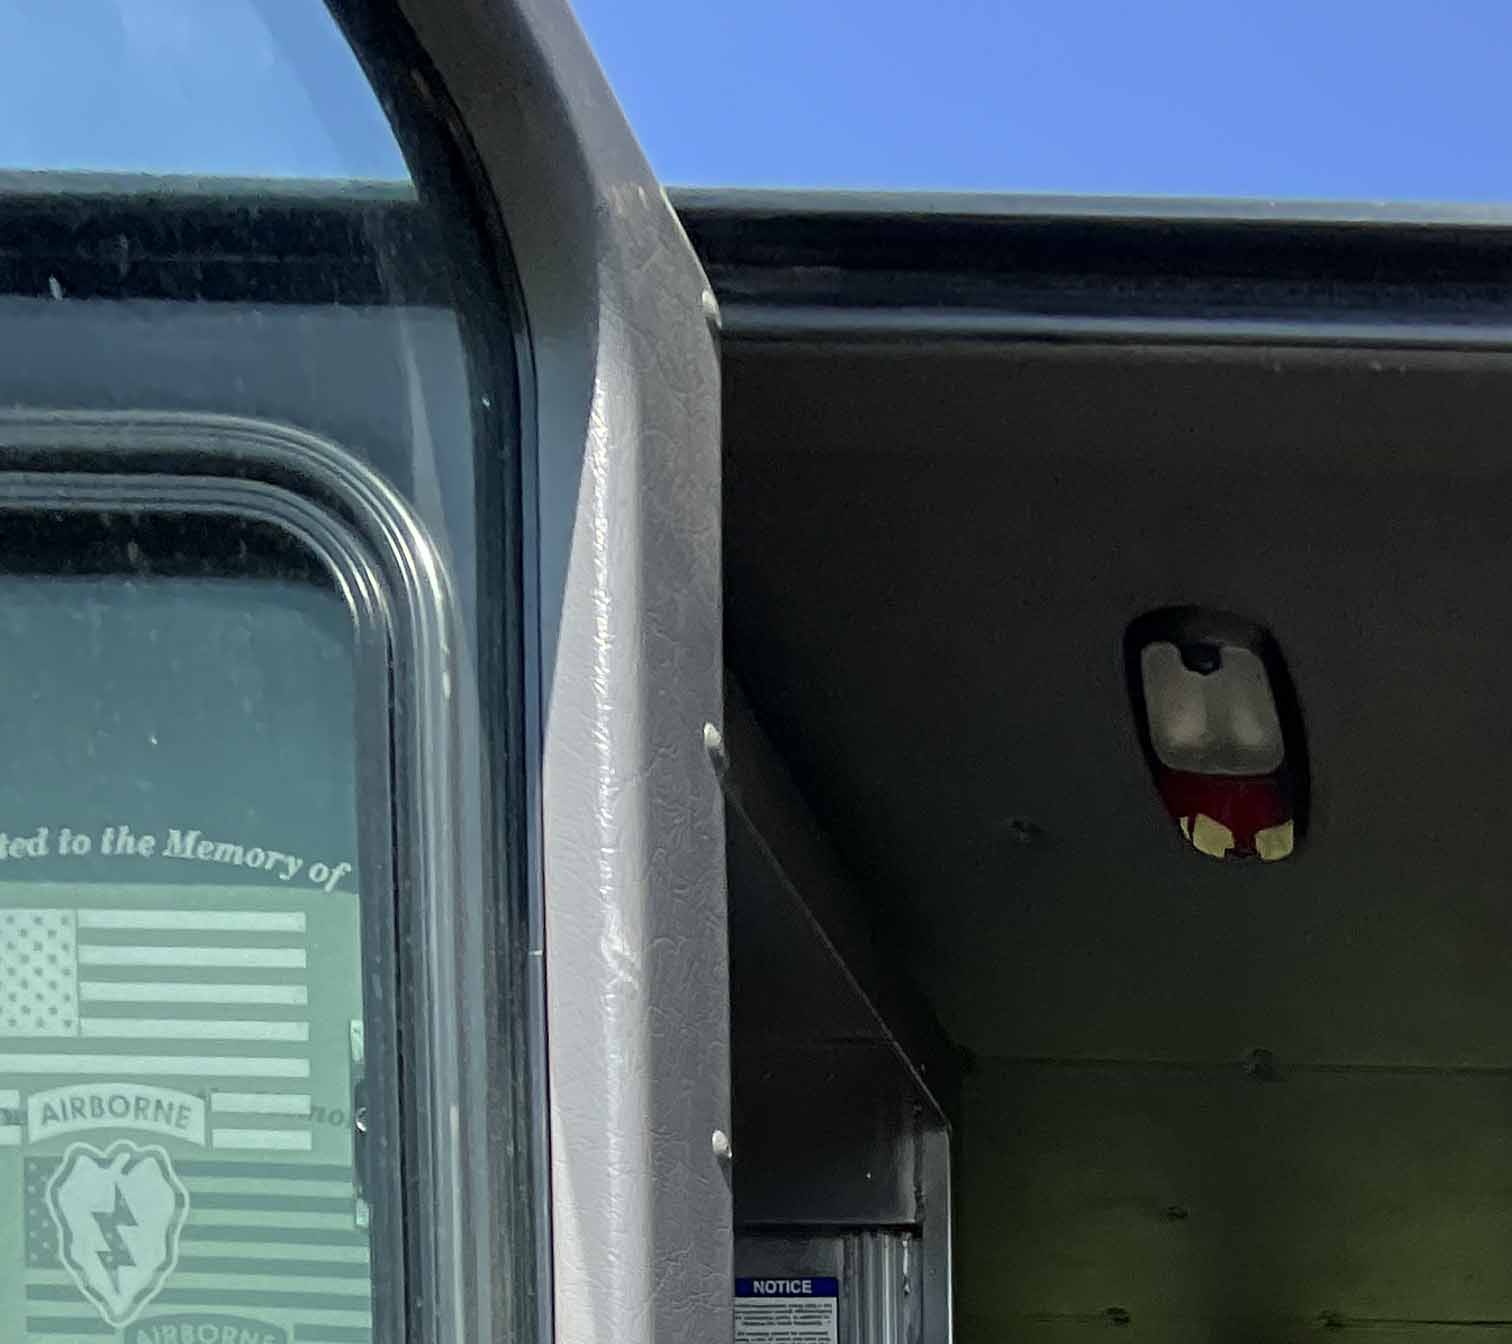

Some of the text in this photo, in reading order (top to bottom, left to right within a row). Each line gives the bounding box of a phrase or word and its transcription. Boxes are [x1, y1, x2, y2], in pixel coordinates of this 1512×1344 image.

[59, 827, 91, 855] to
[101, 825, 155, 856] the
[162, 828, 303, 880] Memory
[309, 860, 352, 892] of
[41, 1094, 192, 1129] AIRBORNE
[753, 1280, 812, 1294] NOTICE
